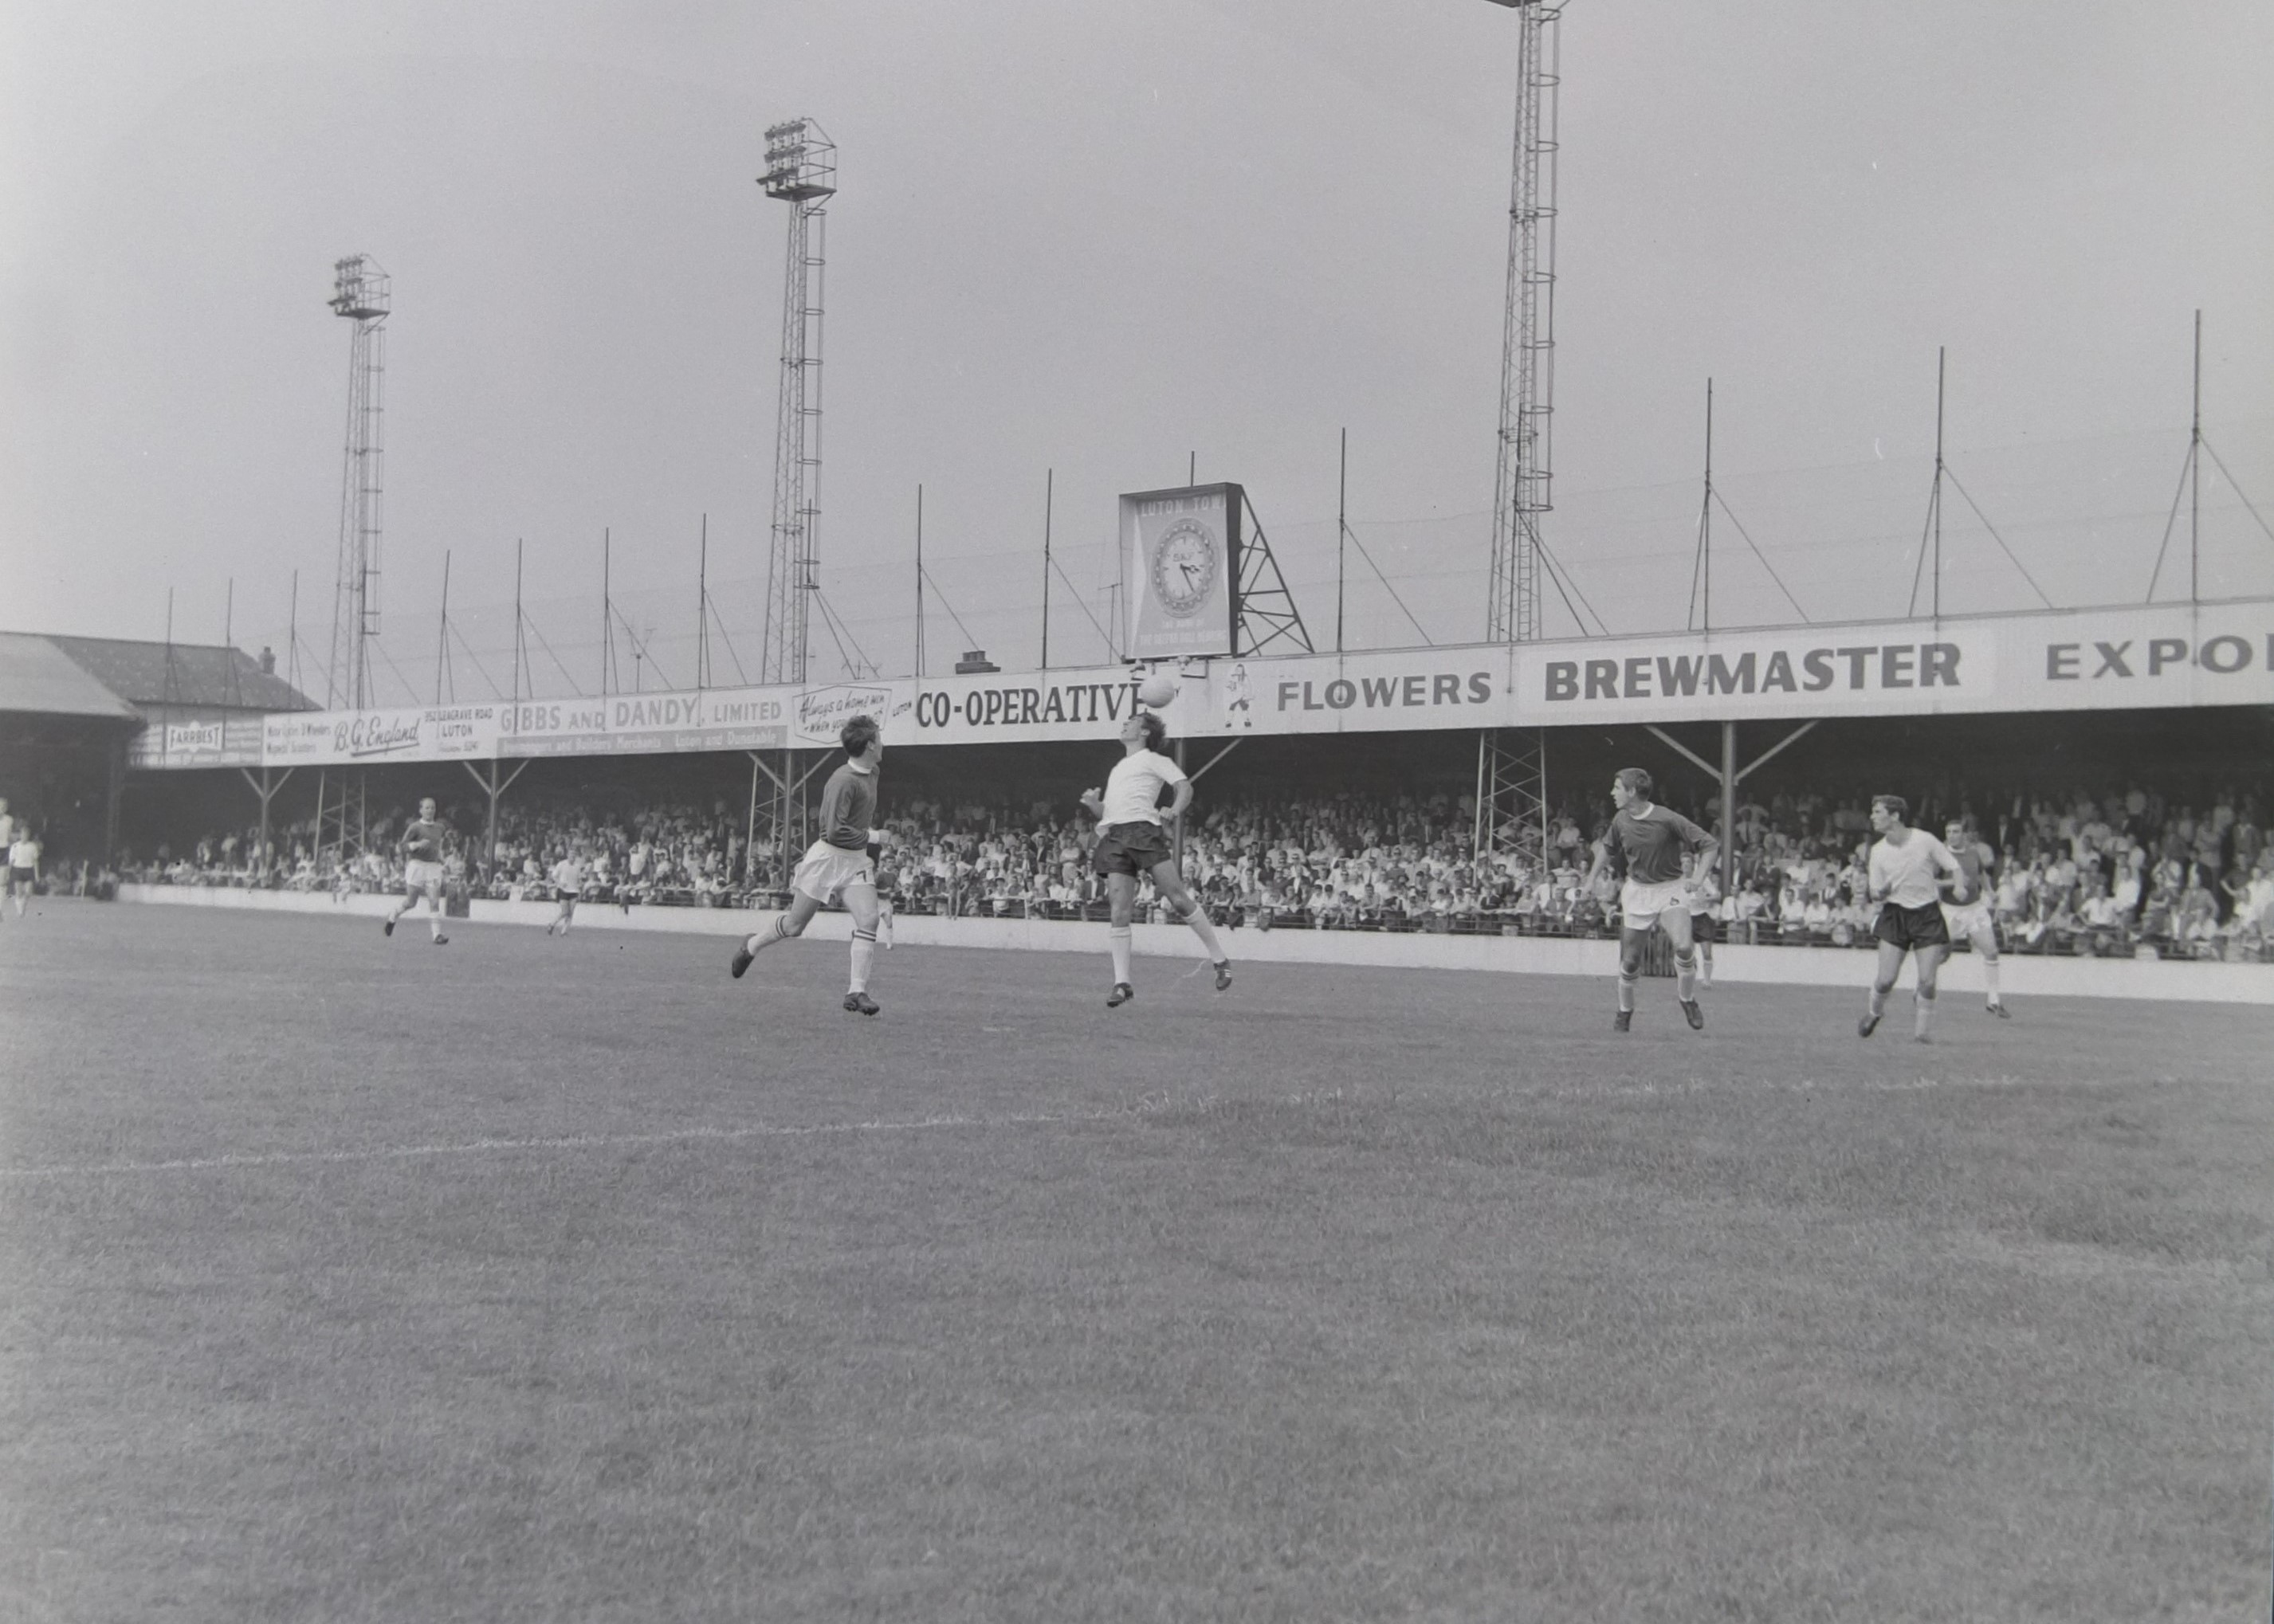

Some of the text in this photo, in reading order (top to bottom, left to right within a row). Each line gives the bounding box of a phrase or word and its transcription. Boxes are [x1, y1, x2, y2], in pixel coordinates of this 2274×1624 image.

[1141, 499, 1184, 516] LUTON
[1545, 643, 1961, 701] BREWMASTER
[845, 690, 870, 709] home
[1278, 673, 1491, 712] FLOWERS
[501, 707, 561, 732] GIBBS
[568, 711, 606, 730] AND
[714, 701, 781, 722] LIMITED
[893, 700, 912, 716] LUTON
[367, 716, 421, 755] England
[442, 724, 473, 738] LUTON
[856, 870, 866, 882] 7
